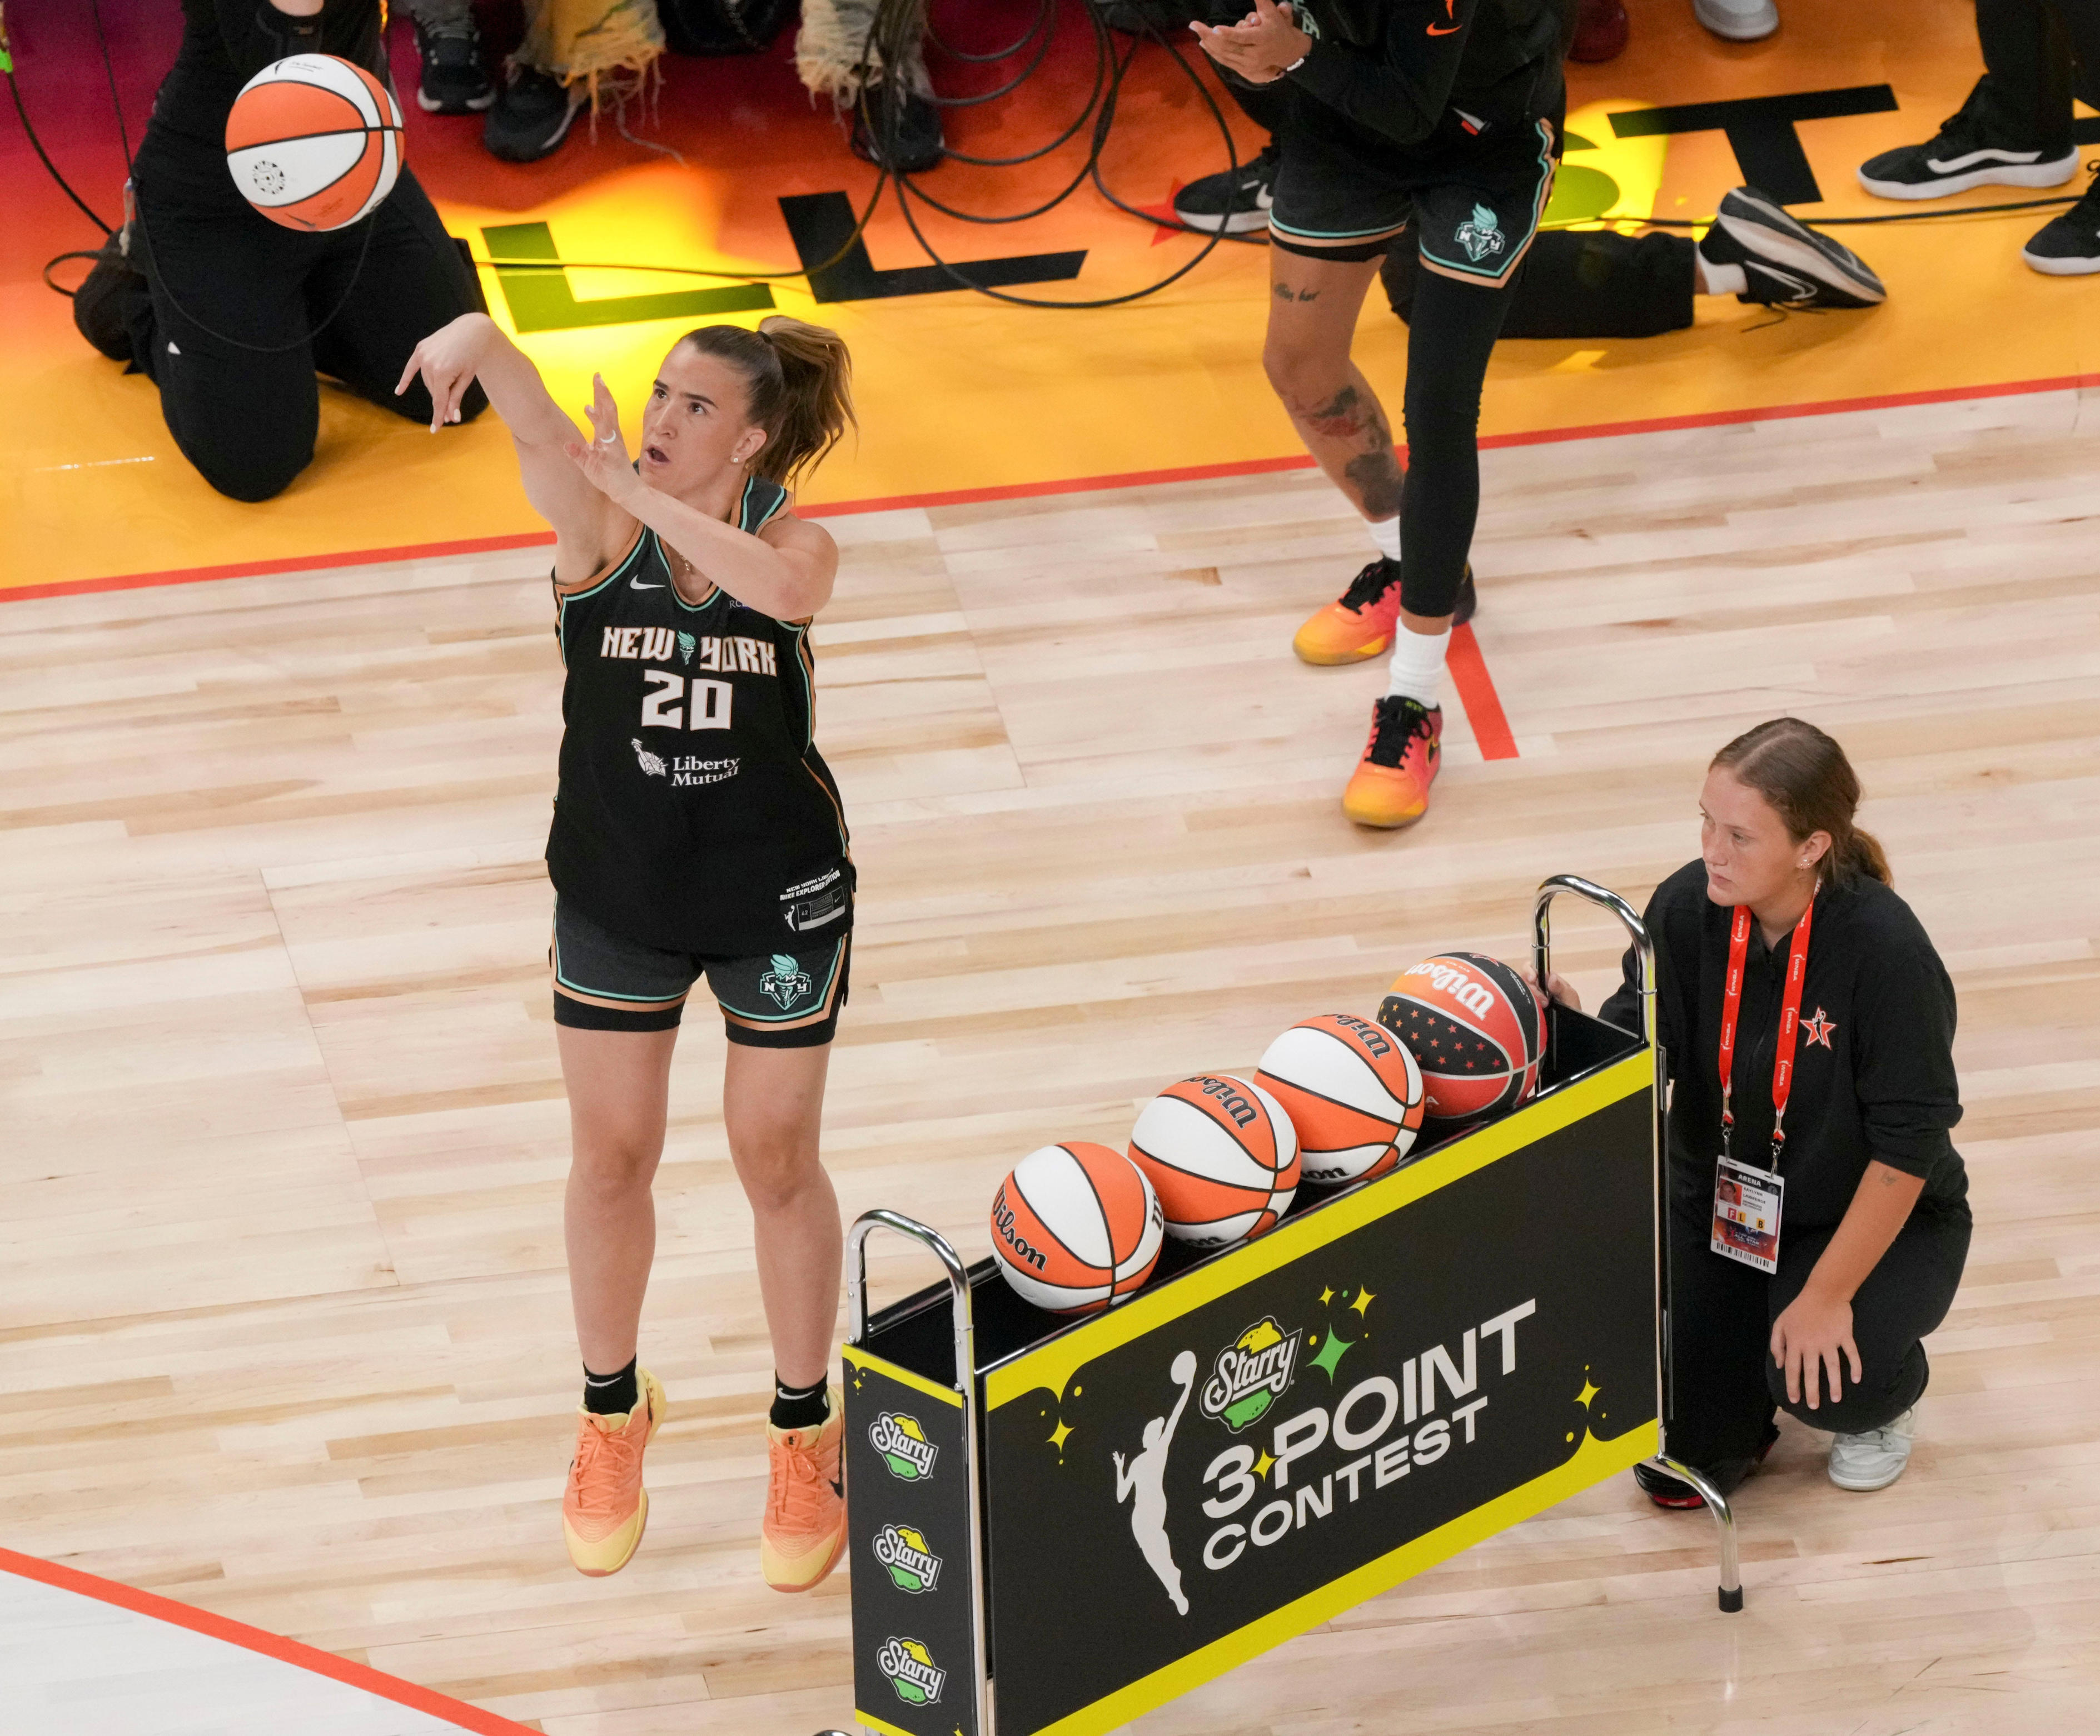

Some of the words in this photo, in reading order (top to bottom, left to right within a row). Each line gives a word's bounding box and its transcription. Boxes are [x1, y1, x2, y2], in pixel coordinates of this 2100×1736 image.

[600, 626, 674, 661] NEW
[700, 636, 777, 677] YORK
[641, 669, 733, 731] 20
[670, 765, 739, 787] Mutual
[673, 755, 741, 772] Liberty
[779, 892, 795, 901] NIKE
[795, 881, 825, 897] EXPLORER
[786, 884, 800, 893] NEW
[801, 878, 818, 888] YORK
[1404, 962, 1495, 1021] Wilson
[1321, 1014, 1391, 1060] Wils
[1183, 1076, 1257, 1130] Wilso
[1738, 1175, 1761, 1187] ARENA
[1204, 1337, 1296, 1413] Starry
[1202, 1444, 1255, 1519] 3
[1273, 1298, 1536, 1490] POINT
[872, 1416, 934, 1475] Starry
[1203, 1396, 1489, 1571] CONTEST
[876, 1528, 938, 1588] Starry
[880, 1640, 942, 1700] Starry
